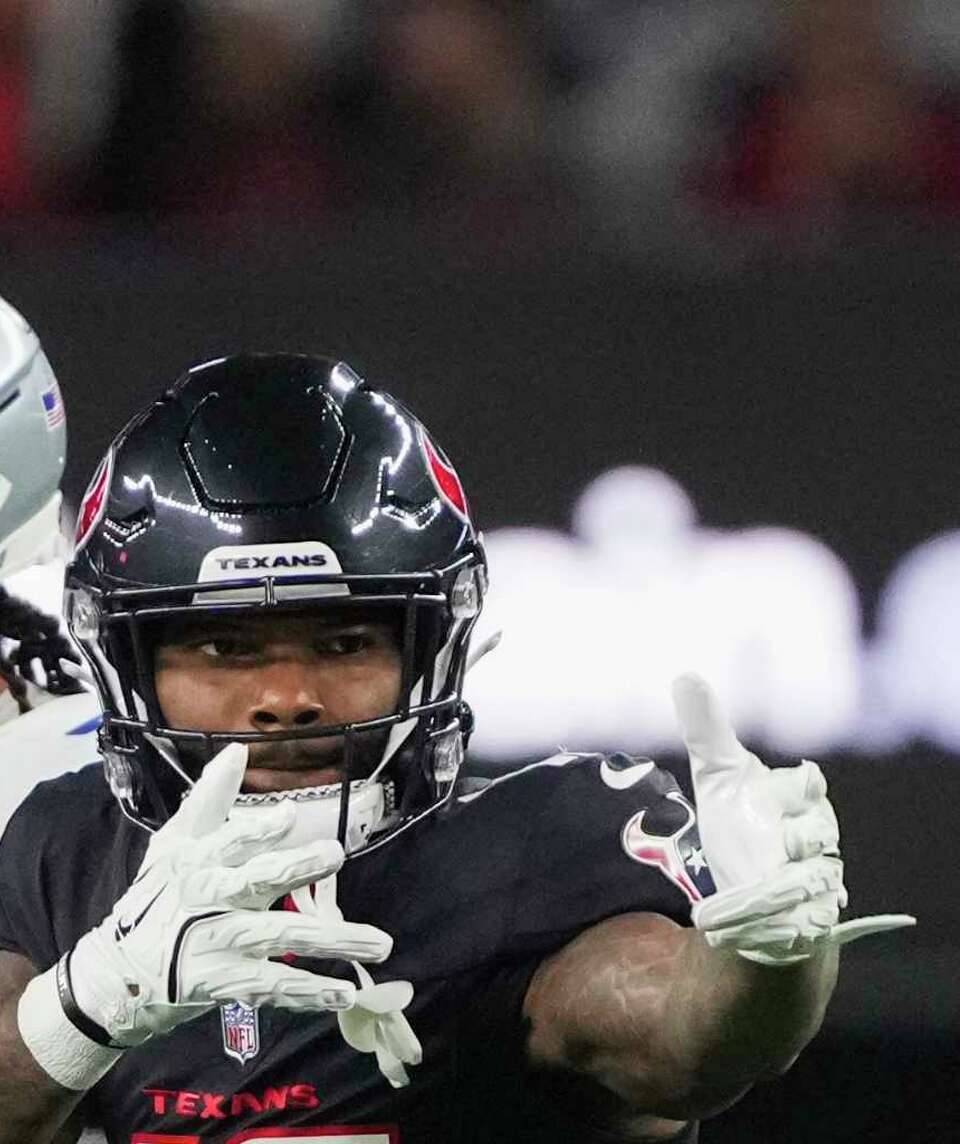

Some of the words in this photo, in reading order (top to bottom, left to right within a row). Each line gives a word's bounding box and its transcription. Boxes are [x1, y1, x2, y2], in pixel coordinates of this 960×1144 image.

[216, 554, 328, 570] TEXANS
[226, 1024, 256, 1052] NFL
[141, 1083, 321, 1120] TEXANS
